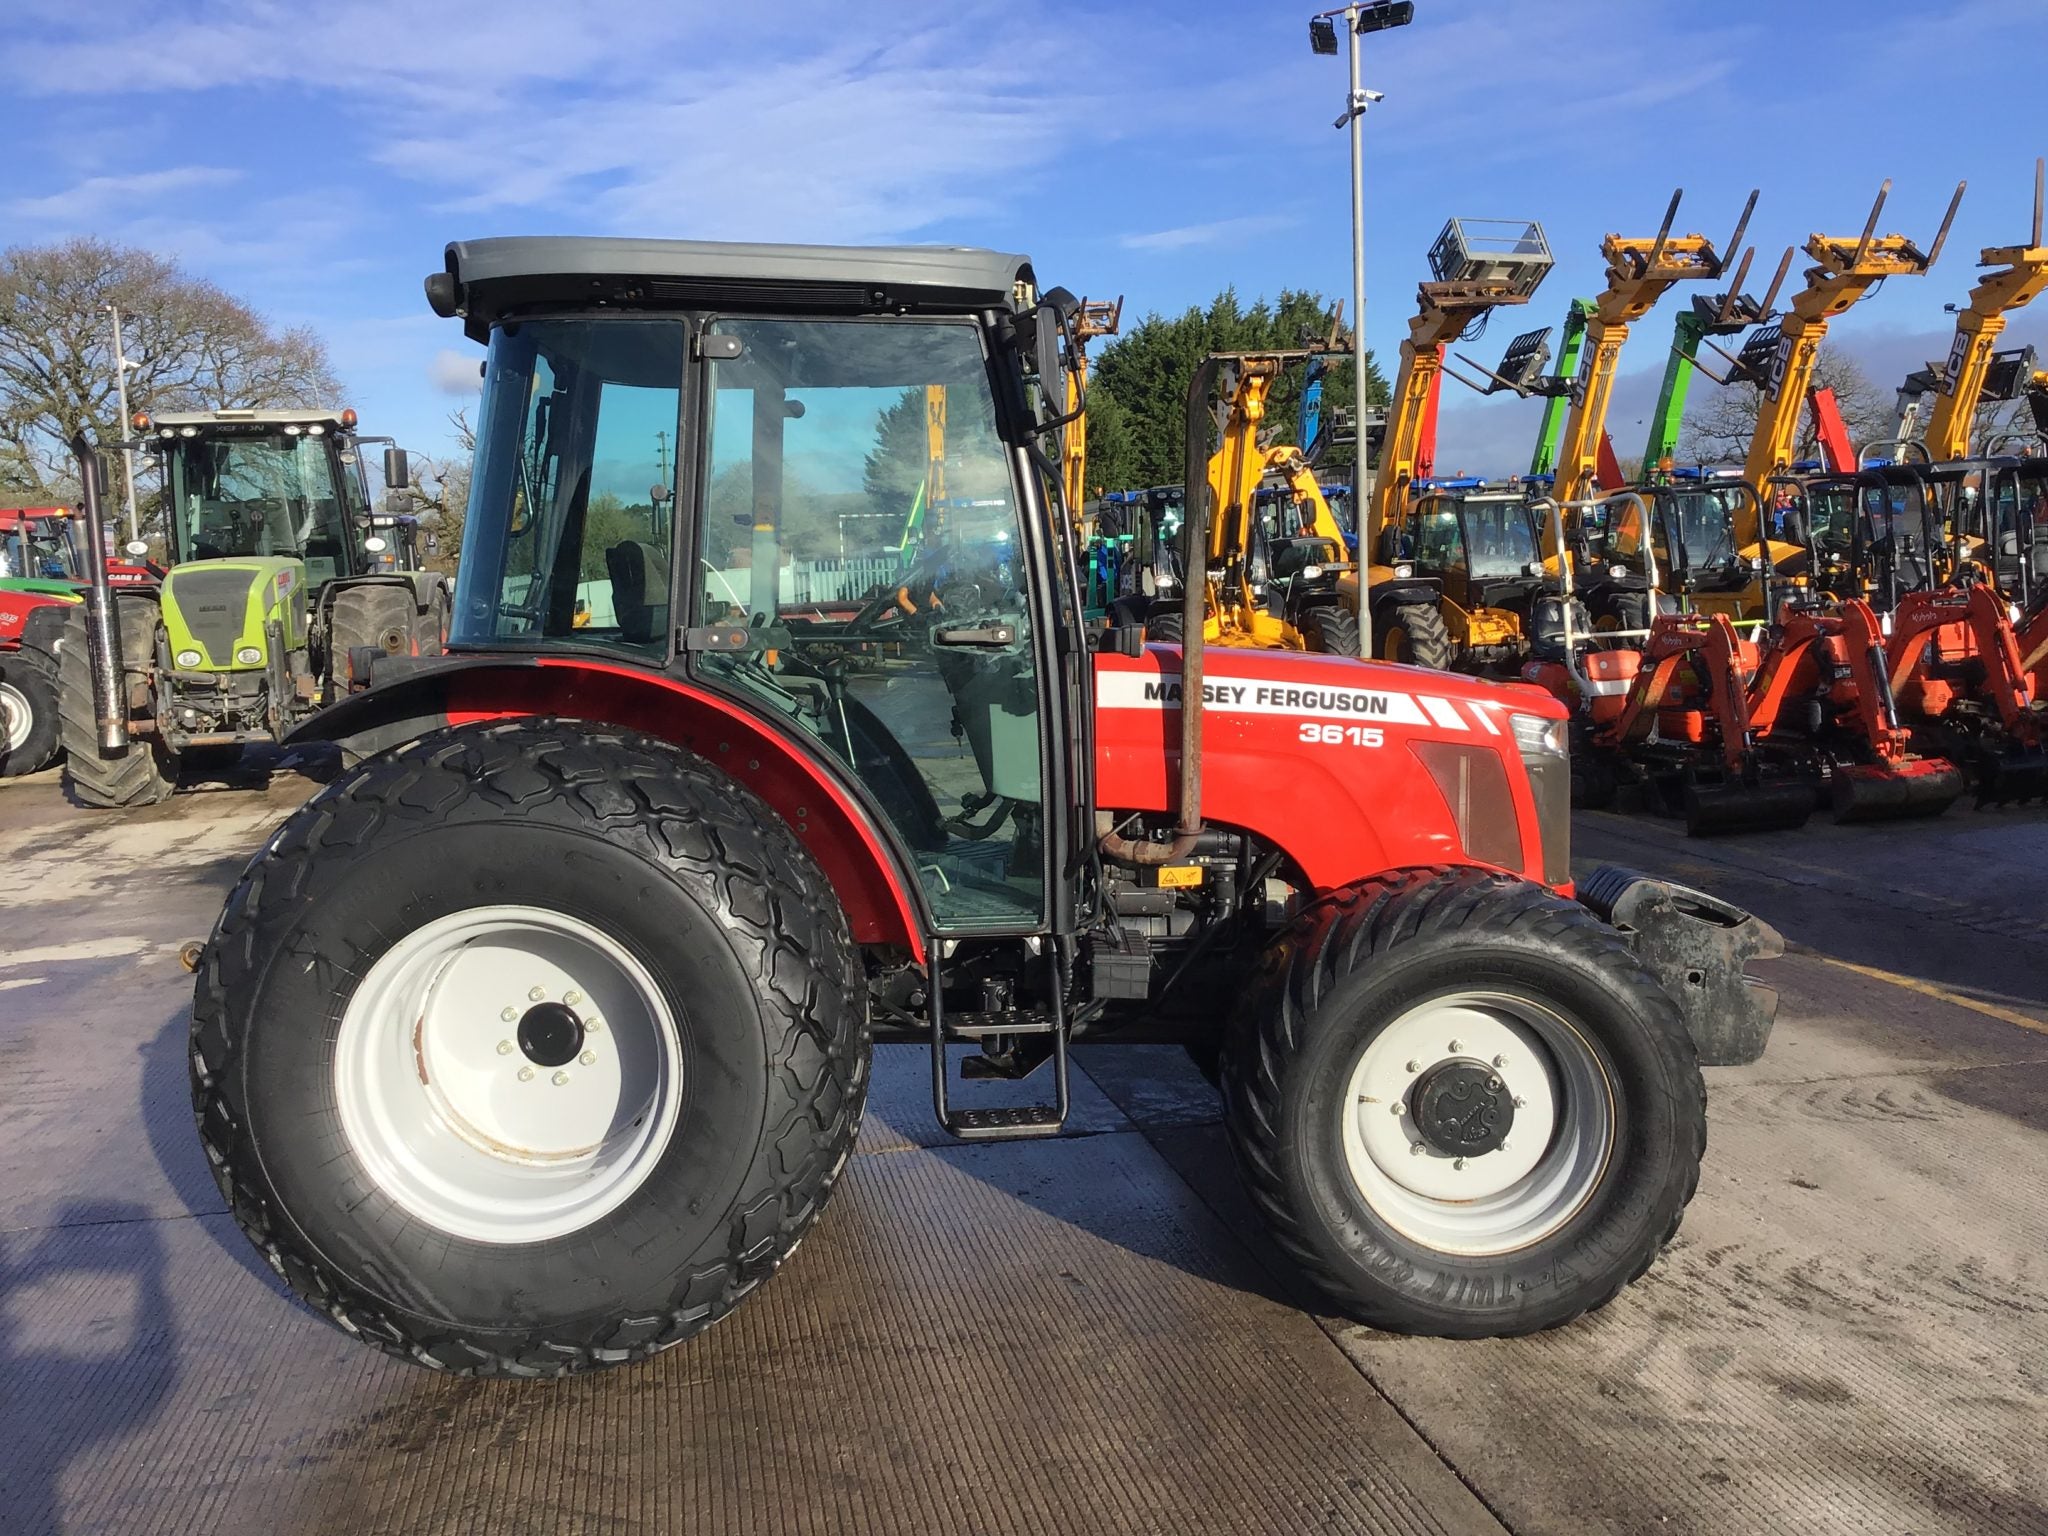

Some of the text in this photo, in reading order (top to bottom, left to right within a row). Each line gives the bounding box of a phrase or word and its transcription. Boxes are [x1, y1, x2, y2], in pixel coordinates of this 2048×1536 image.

[1577, 340, 1596, 408] JCB
[1768, 336, 1792, 402] JCB
[1944, 332, 1969, 396] JCB
[1144, 681, 1388, 714] MASEY FERGUSON
[1299, 722, 1384, 748] 3615
[1426, 1270, 1516, 1306] TWIN
